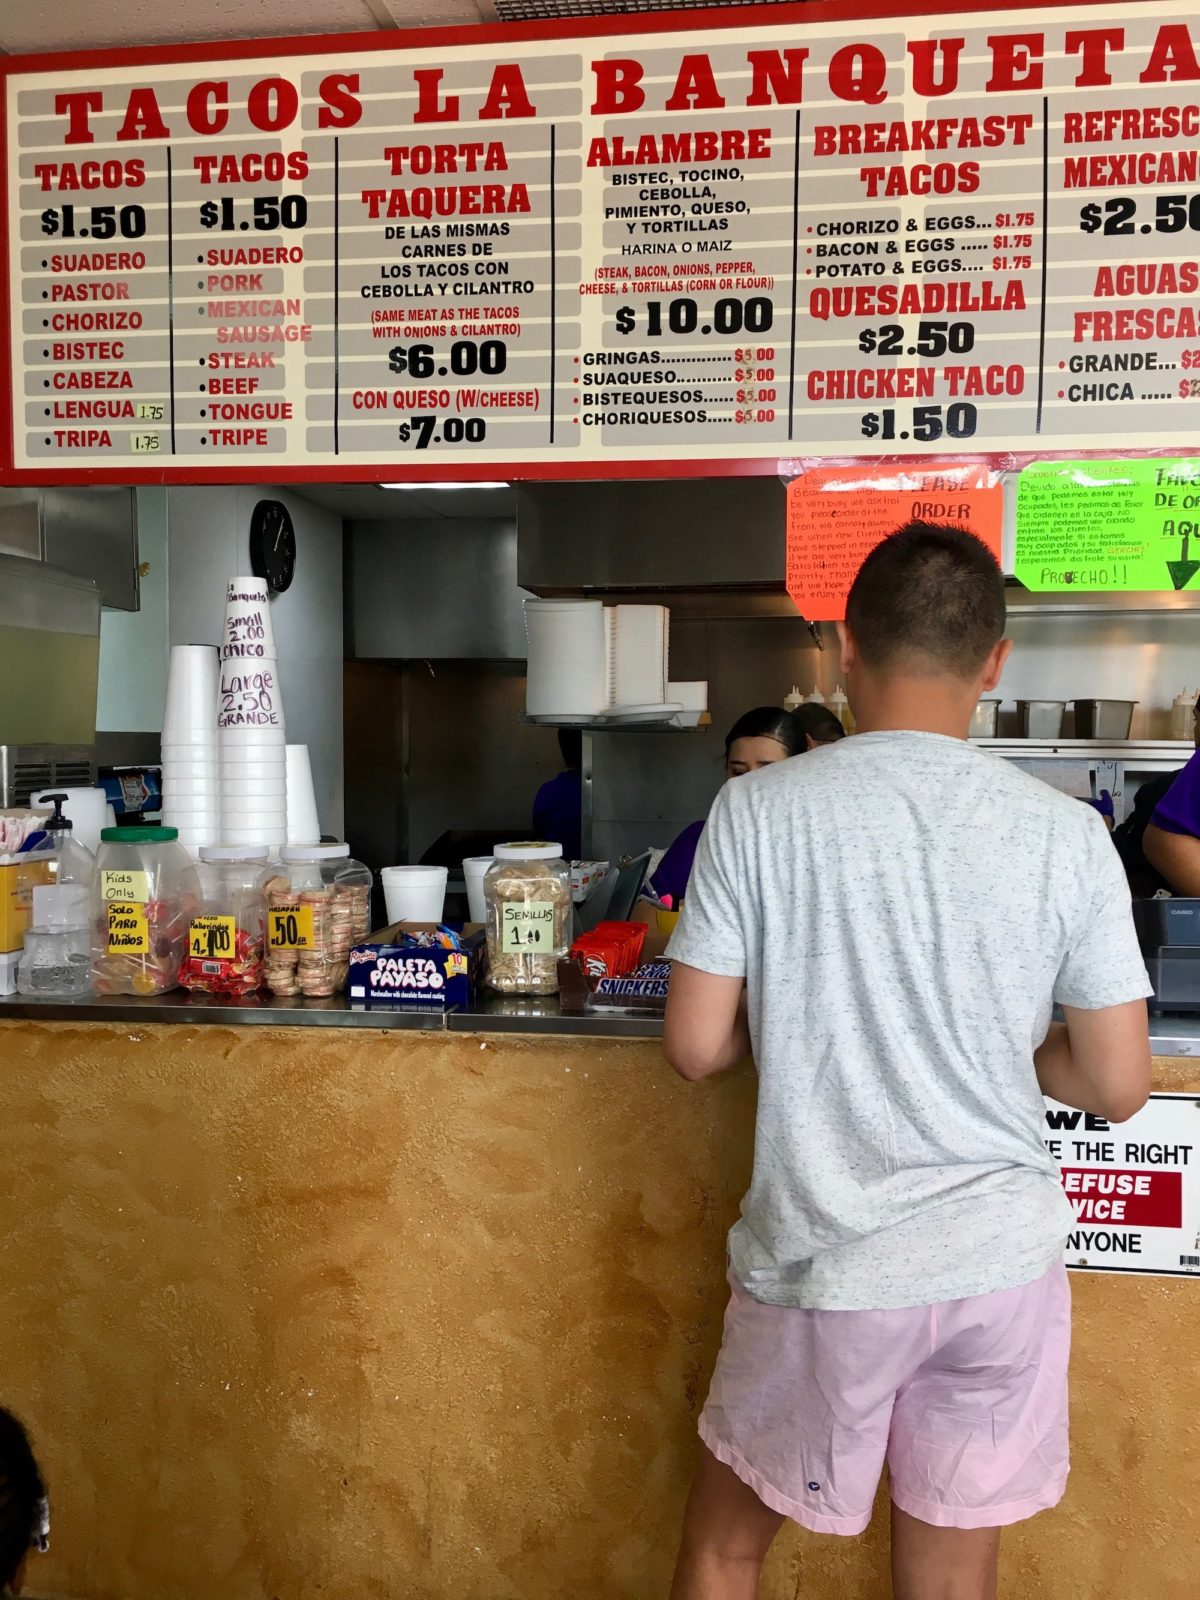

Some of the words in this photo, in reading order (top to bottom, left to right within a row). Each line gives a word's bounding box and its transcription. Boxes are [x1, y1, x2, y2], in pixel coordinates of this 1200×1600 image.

[55, 74, 362, 144] TACOS
[414, 64, 536, 123] LA
[590, 24, 1200, 115] BANQUETA
[1064, 105, 1200, 144] REFRESC
[814, 114, 1033, 156] BREAKFAST
[587, 128, 771, 167] ALAMBRE
[194, 151, 309, 184] TACOS
[384, 141, 508, 176] TORTA
[34, 159, 145, 191] TACOS
[612, 171, 674, 186] BISTEC,
[679, 168, 744, 183] TOCINO,
[860, 161, 980, 197] TACOS
[1064, 150, 1198, 189] MEXICAN
[362, 183, 531, 220] TAQUERA
[639, 186, 716, 201] CEBOLLA,
[200, 195, 307, 230] $1.50
[605, 204, 685, 219] PIMIENTO,
[691, 201, 751, 215] QUESO,
[41, 204, 146, 239] $1.50
[385, 226, 405, 240] DE
[411, 224, 441, 239] LAS
[447, 222, 510, 237] MISMAS
[626, 223, 636, 234] Y
[642, 218, 729, 234] TORTILLAS
[817, 220, 899, 236] CHORIZO
[906, 218, 918, 231] &
[995, 212, 1034, 228] $1.75
[401, 243, 466, 258] CARNES
[472, 242, 493, 256] DE
[622, 242, 677, 256] HARINA
[681, 242, 691, 253] O
[697, 240, 732, 252] MAIZ
[816, 242, 878, 257] BACON
[886, 240, 898, 253] &
[905, 238, 955, 253] EGGS
[993, 234, 1032, 250] $1.75
[51, 252, 145, 272] SUADERO
[207, 247, 303, 266] SUADERO
[381, 264, 411, 279] LOS
[417, 262, 470, 277] TACOS
[474, 261, 509, 276] CON
[594, 267, 632, 281] (STEAK,
[634, 265, 670, 279] BACON,
[673, 264, 713, 278] ONIONS,
[716, 262, 756, 276] PEPPER,
[815, 262, 886, 278] POTATO
[892, 261, 904, 274] &
[992, 256, 1031, 271] $1.75
[207, 274, 264, 292] PORK
[579, 283, 619, 296] CHEESE,
[621, 282, 628, 293] &
[632, 281, 683, 293] TORTILLAS
[686, 279, 717, 293] (CORN
[720, 279, 732, 290] OR
[1094, 262, 1199, 297] AGUAS
[52, 282, 129, 302] PASTOR
[361, 283, 434, 299] CEBOLLA
[437, 283, 448, 296] Y
[453, 280, 534, 296] CILANTRO
[208, 299, 300, 318] MEXICAN
[810, 280, 1026, 321] QUESADILLA
[52, 312, 143, 331] CHORIZO
[371, 309, 405, 323] (SAME
[408, 309, 438, 322] MEAT
[440, 308, 455, 321] AS
[458, 307, 480, 320] THE
[483, 306, 520, 319] TACOS
[616, 297, 773, 336] $10.00
[216, 325, 312, 344] SAUSAGE
[372, 326, 401, 338] WITH
[404, 325, 447, 339] ONIONS
[450, 324, 458, 336] &
[461, 323, 521, 338] CILANTRO)
[1073, 307, 1200, 343] FRESCA
[859, 321, 974, 357] $2.50
[53, 342, 124, 360] BISTEC
[208, 352, 275, 369] STEAK
[388, 340, 507, 379] $6.00
[53, 371, 133, 389] CABEZA
[209, 378, 259, 394] BEEF
[807, 367, 936, 401] CHICKEN
[944, 364, 1024, 396] TACO
[352, 391, 388, 410] CON
[393, 389, 450, 410] QUESO
[456, 388, 540, 412] (W/CHEESE)
[1068, 383, 1134, 402] CHICA
[54, 400, 135, 419] LENGUA
[140, 406, 163, 420] 1.75
[209, 403, 293, 420] TONGUE
[861, 402, 977, 442] $1.50
[54, 430, 112, 447] TRIPA
[209, 428, 267, 445] TRIPE
[399, 415, 486, 450] $7.00
[135, 436, 159, 450] 1.75
[899, 474, 969, 492] EASE
[1155, 493, 1178, 507] DE
[911, 501, 971, 519] ORDER
[227, 612, 263, 629] Small
[229, 626, 265, 642] 2.00
[221, 670, 273, 694] Large
[222, 691, 273, 712] 2.50
[218, 712, 279, 728] GRANDE
[106, 872, 132, 883] Kids
[106, 887, 134, 899] Only
[377, 958, 437, 973] PALETA
[452, 953, 463, 965] 10
[370, 970, 444, 989] PAYASO
[600, 978, 669, 996] SNICKERS
[1045, 1110, 1110, 1132] WE
[1072, 1141, 1115, 1162] THE
[1125, 1143, 1193, 1165] RIGHT
[1061, 1172, 1152, 1196] EFUSE
